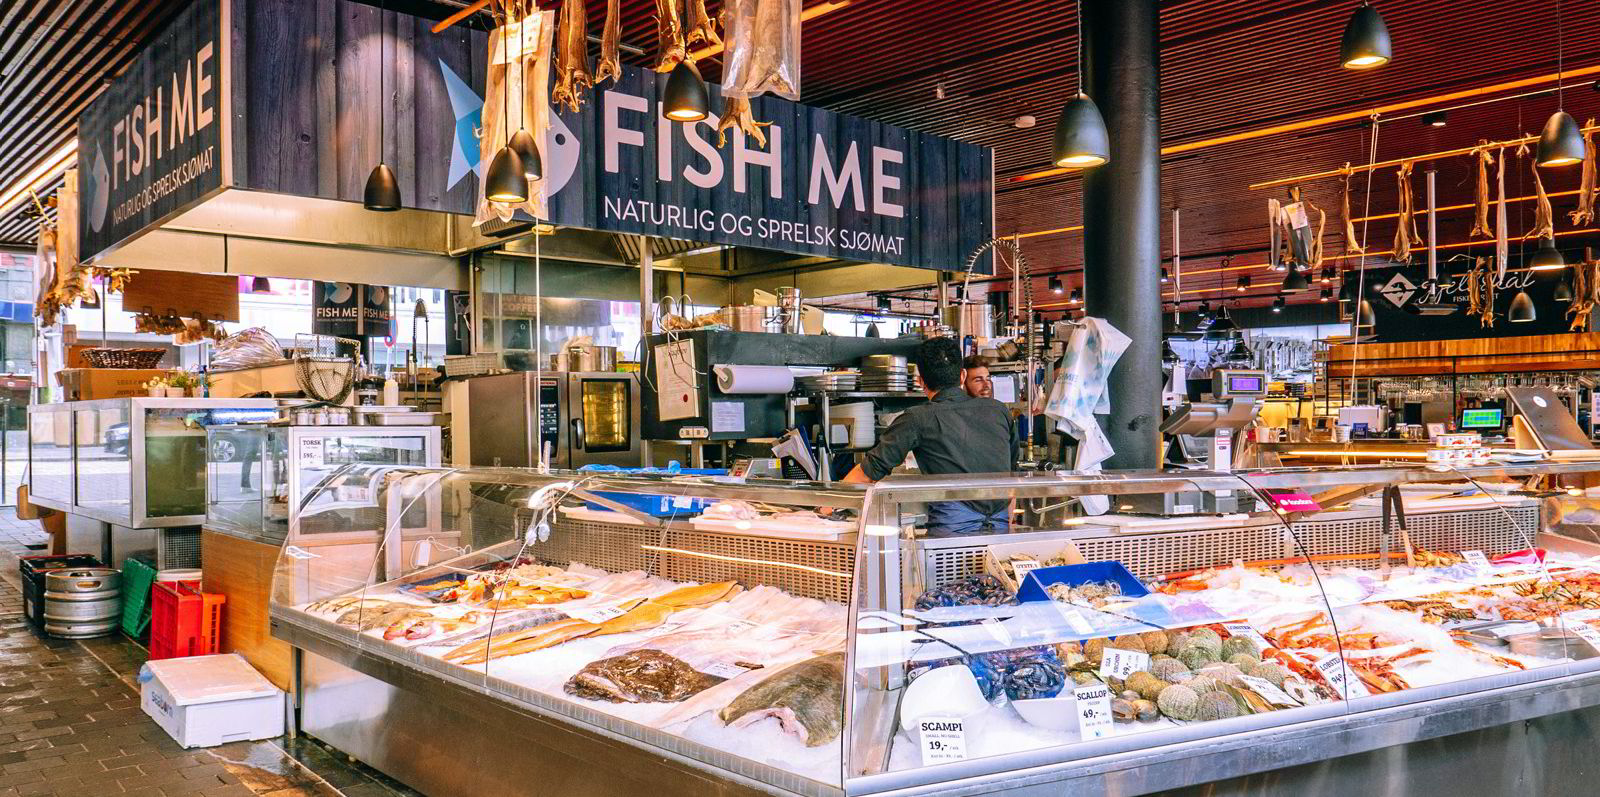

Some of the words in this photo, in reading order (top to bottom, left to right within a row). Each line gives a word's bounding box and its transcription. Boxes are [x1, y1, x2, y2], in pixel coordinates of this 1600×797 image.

[113, 86, 162, 190] FISH
[170, 41, 214, 150] ME
[604, 90, 782, 199] FISH
[808, 133, 904, 218] ME
[113, 193, 141, 225] NATURLIG
[142, 186, 152, 206] OG
[152, 167, 182, 201] SPRELSK
[182, 146, 214, 187] SJØMAT
[604, 195, 715, 231] NATURLIG
[720, 212, 753, 236] OG
[757, 217, 836, 247] SPRELSK
[840, 229, 905, 255] SJØMAT
[316, 307, 340, 318] FISH
[341, 307, 358, 318] ME
[363, 307, 378, 319] FISH
[379, 310, 389, 320] ME
[1076, 689, 1108, 701] SCALLOP
[1083, 708, 1099, 719] 49,-
[921, 722, 963, 732] SCAMPI
[929, 741, 948, 751] 19,-
